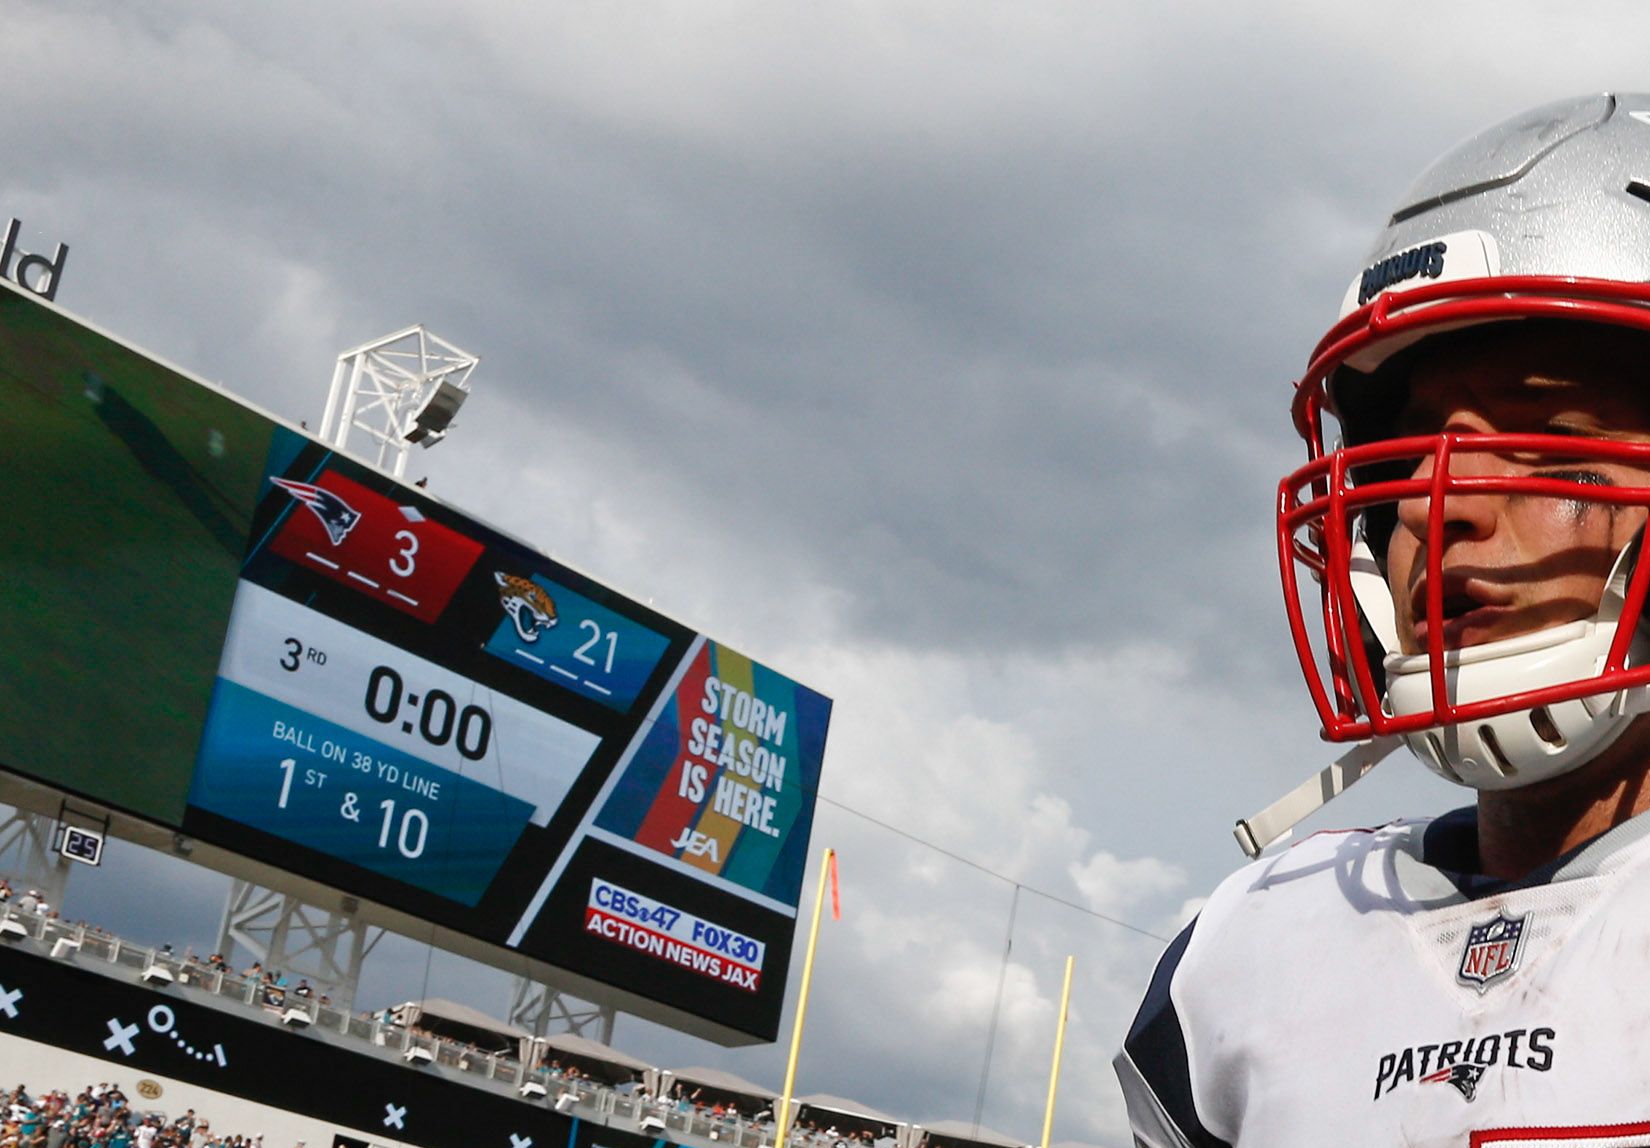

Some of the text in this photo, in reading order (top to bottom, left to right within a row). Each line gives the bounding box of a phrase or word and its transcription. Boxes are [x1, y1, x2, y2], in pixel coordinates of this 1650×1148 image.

[389, 530, 419, 577] 3
[573, 619, 618, 674] 21
[364, 665, 492, 761] 0:00
[701, 676, 787, 746] STORM
[273, 721, 440, 800] BALL ON 38 YD LINE
[688, 717, 786, 792] SEASON
[340, 792, 360, 822] &
[378, 799, 429, 859] 10
[679, 761, 779, 838] IS HERE.
[68, 832, 97, 859] 25
[670, 826, 720, 863] JEA
[586, 914, 760, 991] ACTION NEWS JAX
[692, 922, 759, 963] FOX30
[1465, 942, 1511, 977] NFL
[1373, 1027, 1556, 1102] PATRIOTS
